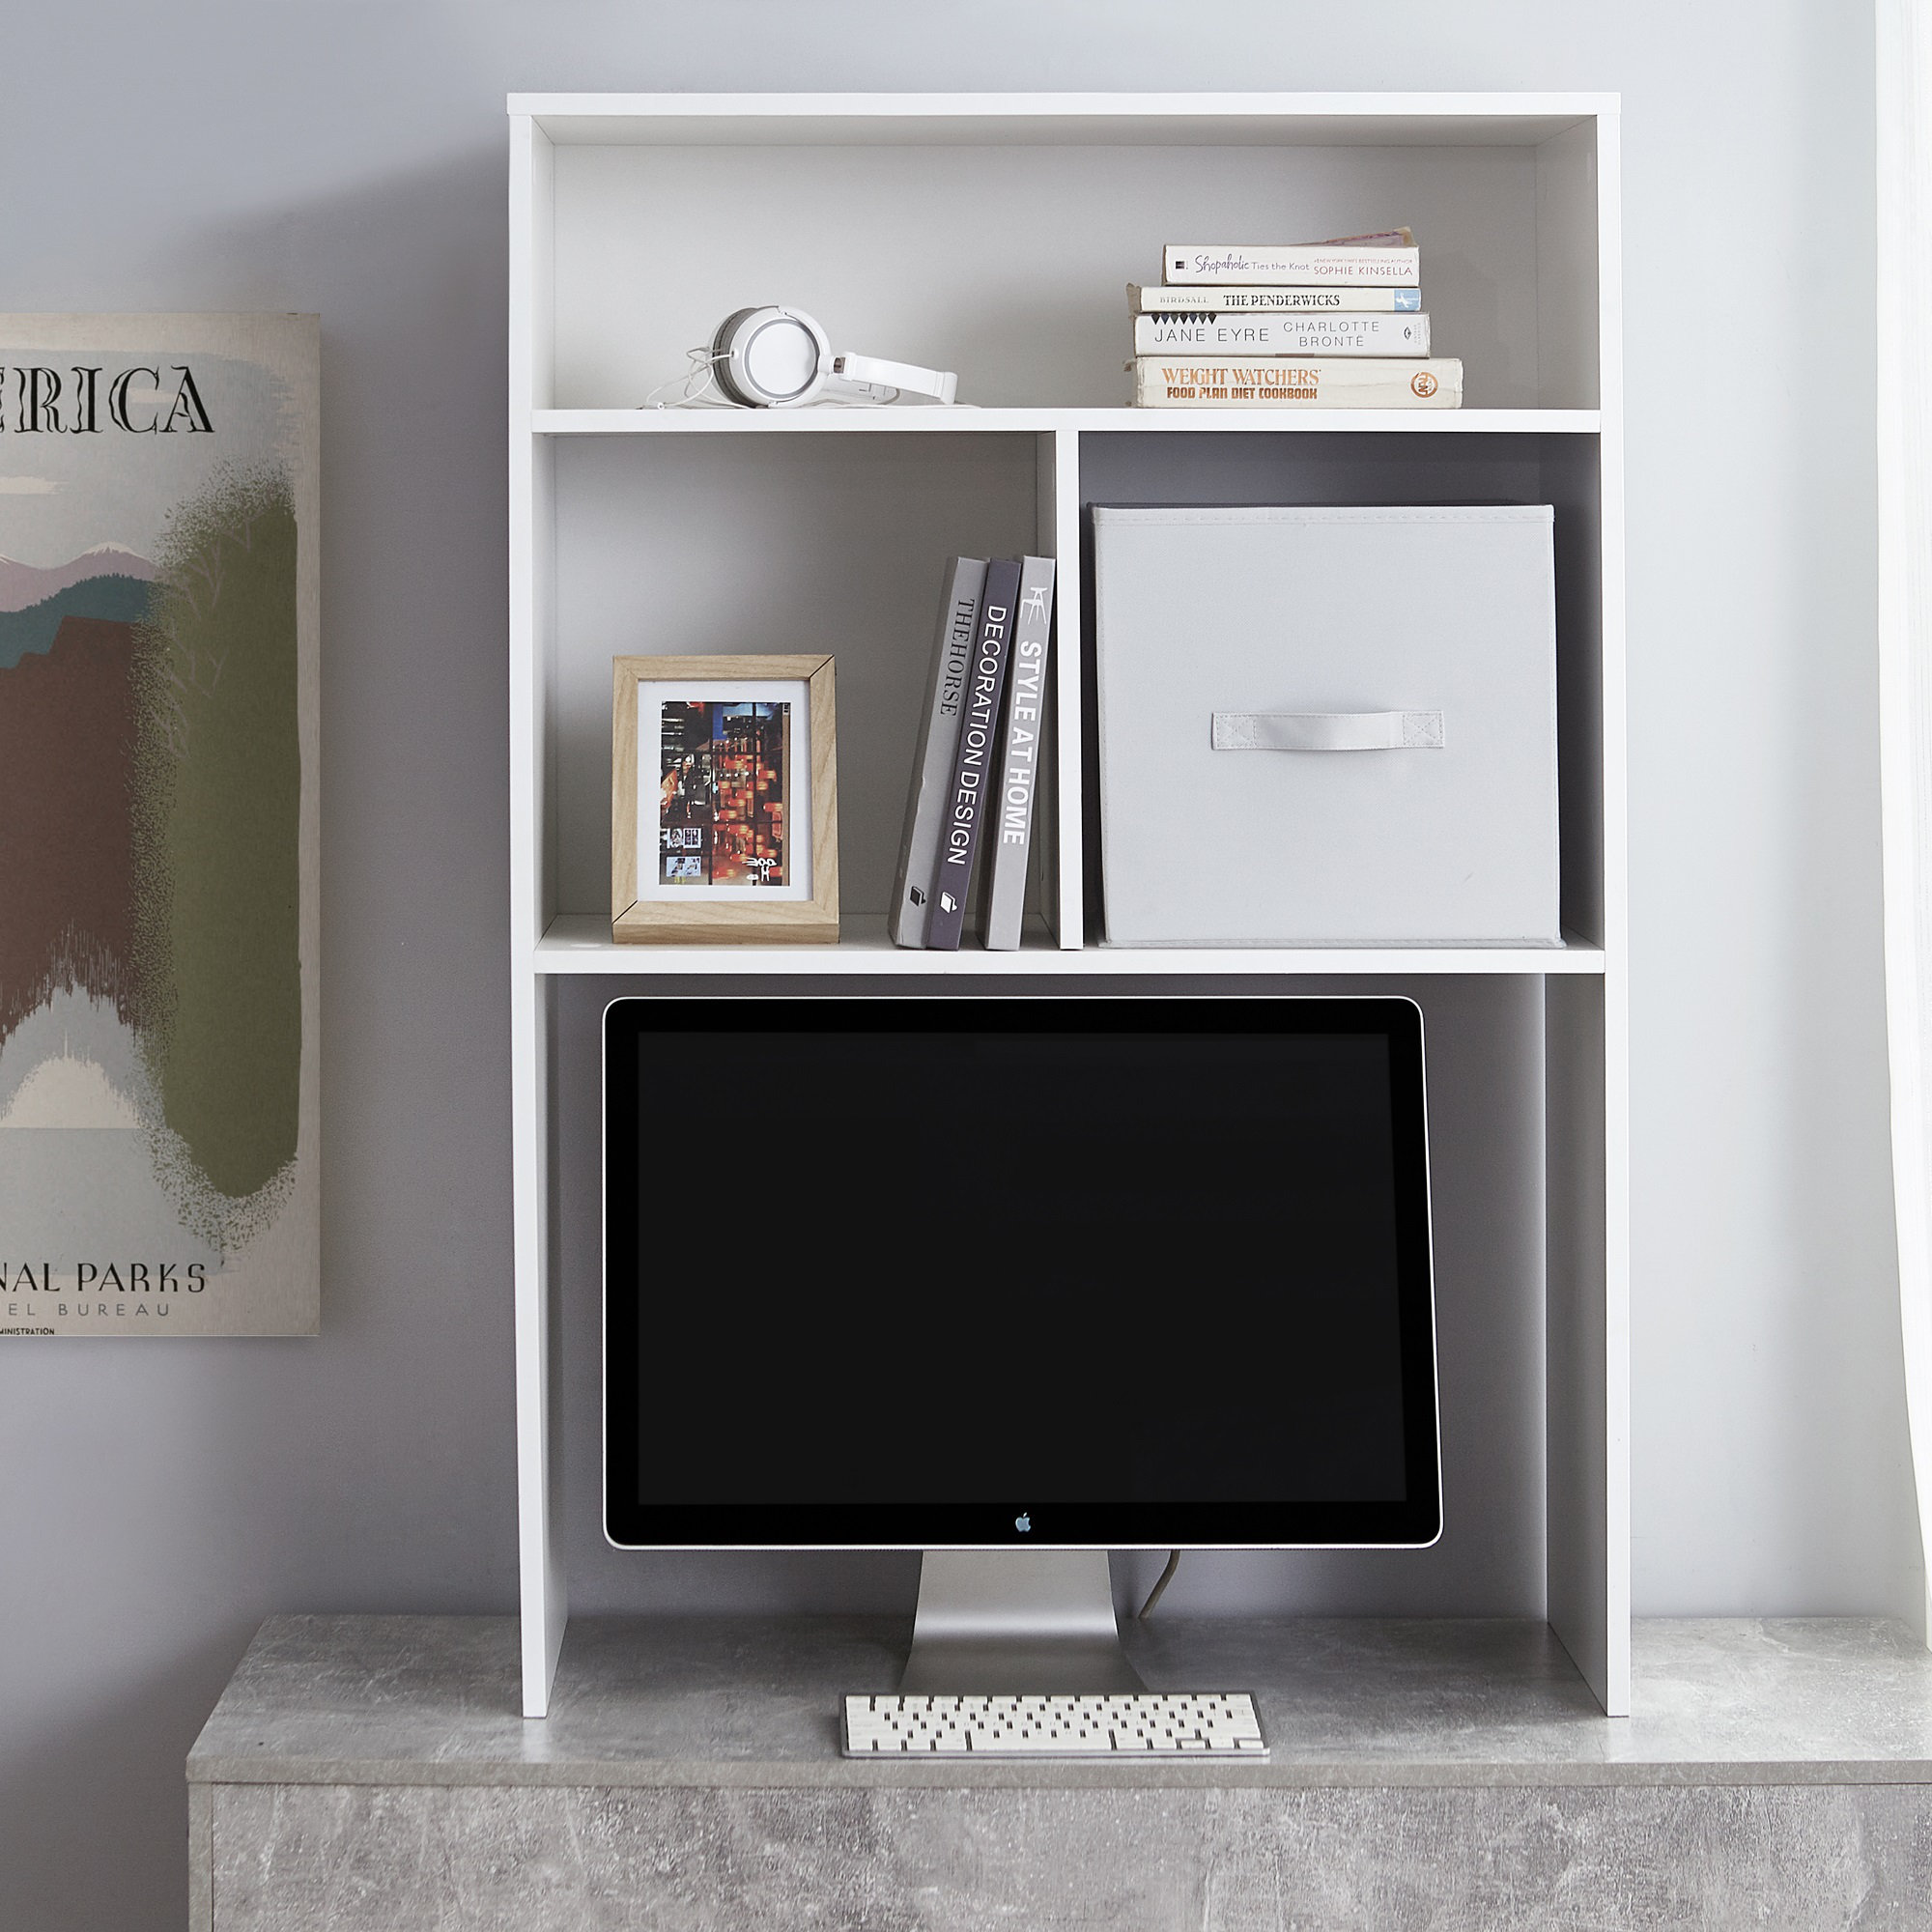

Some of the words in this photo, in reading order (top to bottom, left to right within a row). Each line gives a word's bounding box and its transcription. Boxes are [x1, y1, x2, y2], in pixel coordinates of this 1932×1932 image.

[1194, 253, 1250, 274] Shopaholic
[1251, 262, 1269, 270] Ties
[1271, 261, 1287, 270] the
[1289, 262, 1310, 270] Knot
[1314, 266, 1353, 275] SOPHIE
[1358, 266, 1413, 276] KINSELLA
[1223, 295, 1249, 306] THE
[1250, 295, 1341, 306] PENDERWICKS
[1154, 328, 1206, 342] JANE
[1217, 328, 1269, 342] EYRE
[1283, 321, 1379, 333] CHARLOTTE
[1161, 368, 1229, 386] WEIGHT
[1167, 386, 1196, 399] FOOD
[1198, 386, 1228, 399] PLAN
[1231, 387, 1256, 399] DIET
[1258, 387, 1318, 400] COOKBOOK
[963, 605, 1008, 766] DECORATION
[1014, 640, 1042, 722] STYLE
[1011, 726, 1035, 763] AT
[1003, 767, 1031, 845] HOME
[947, 771, 980, 866] DESIGN
[77, 1262, 206, 1293] PARKS
[58, 1303, 169, 1317] BUREAU
